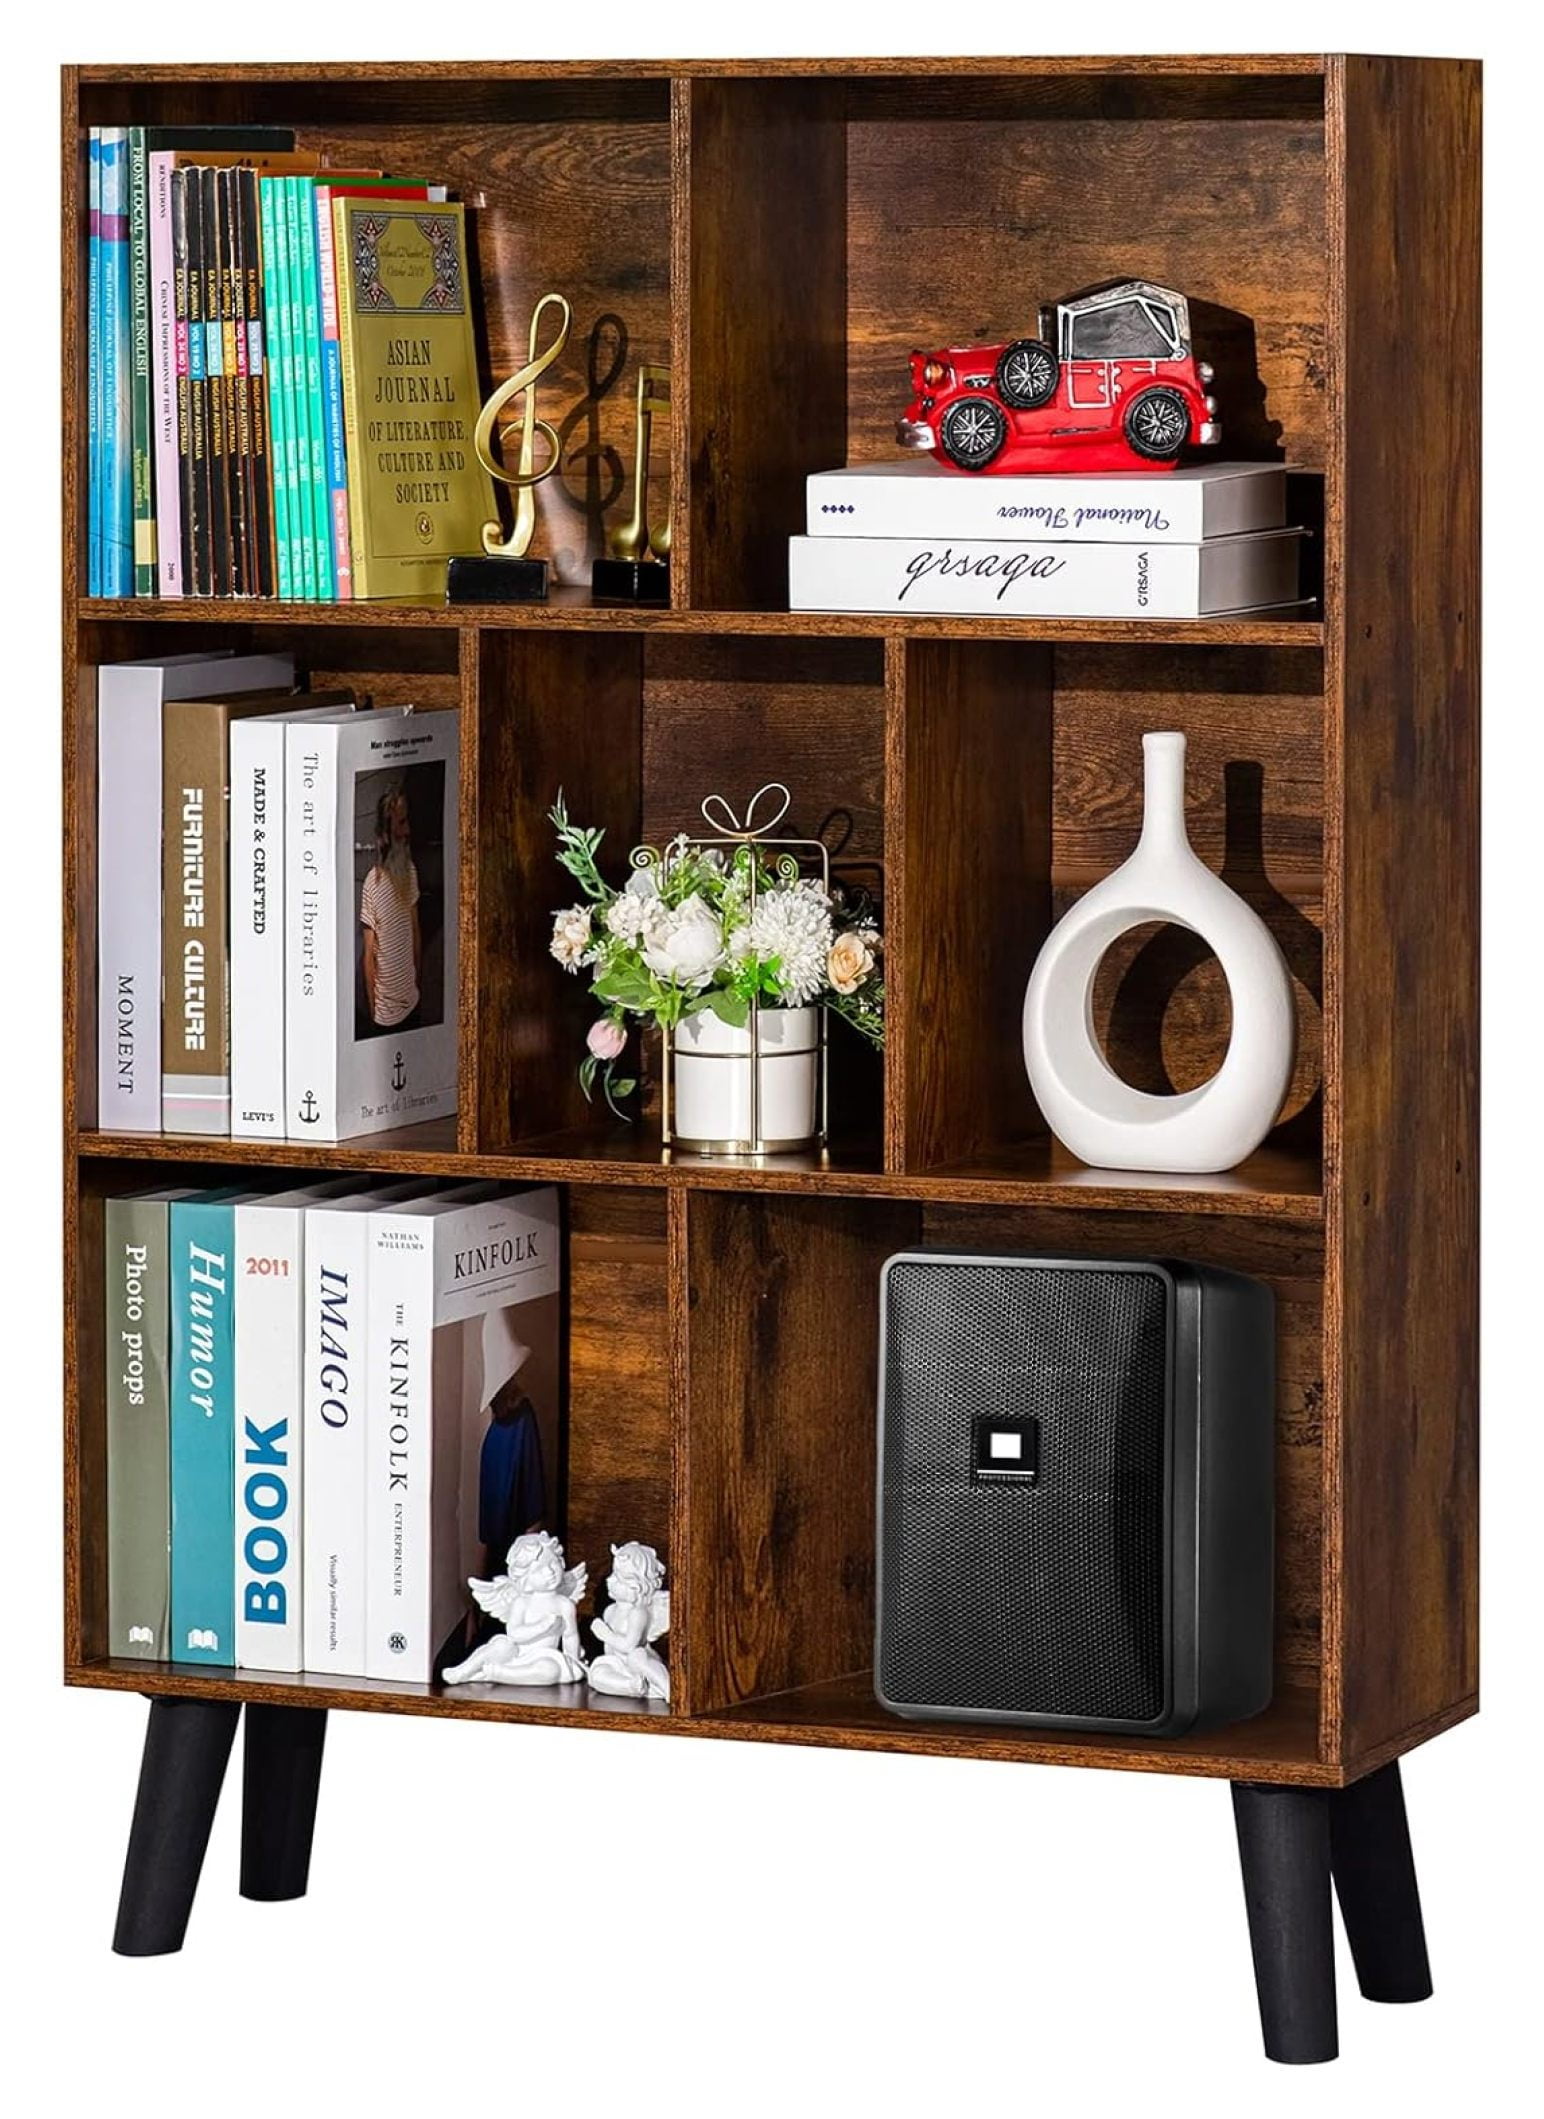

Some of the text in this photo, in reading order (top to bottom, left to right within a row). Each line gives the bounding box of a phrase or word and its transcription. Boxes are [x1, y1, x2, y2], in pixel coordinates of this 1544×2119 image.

[133, 147, 148, 376] FROM LOCAL TO GLOBAL ENGLISH
[176, 268, 186, 318] EA JOURNAL
[190, 271, 199, 320] EA JOURNAL
[208, 270, 217, 318] EA JOURNAL
[222, 269, 231, 318] EA JOURNAL
[235, 269, 244, 317] EA JOURNAL
[248, 269, 258, 318] EA JOURNAL
[105, 317, 114, 361] JOURNAL
[387, 339, 432, 366] ASIAN
[328, 357, 336, 390] JOURNAL
[375, 377, 455, 404] JOURNAL
[178, 376, 189, 455] ENGLISH AUSTRALIA
[194, 381, 204, 459] ENGLISH AUSTRALIA
[212, 377, 222, 455] ENGLISH AUSTRALIA
[226, 375, 236, 454] ENGLISH AUSTRALIA
[238, 377, 249, 455] ENGLISH AUSTRALIA
[253, 377, 263, 455] ENGLISH AUSTRALIA
[368, 421, 469, 442] OF LITERATURE,
[378, 450, 465, 473] CULTURE AND
[396, 482, 450, 504] SOCIETY
[996, 506, 1170, 530] National Flower
[167, 563, 175, 580] 2000
[897, 548, 1066, 600] grsaga
[254, 768, 266, 935] MADE & CRAFTED
[303, 753, 319, 996] The art of libraries
[184, 940, 205, 1050] CULTURE
[117, 975, 134, 1094] MOMENT
[242, 1111, 275, 1122] LEVI'S
[377, 1241, 425, 1250] WILLIAMS
[381, 1232, 419, 1240] NATHAN
[454, 1231, 539, 1280] KINFOLK
[245, 1256, 289, 1277] 2011
[121, 1244, 148, 1405] Photo props
[188, 1241, 226, 1418] Humor
[395, 1304, 404, 1325] THE
[319, 1265, 349, 1429] IMAGO
[389, 1338, 409, 1491] KINFOLK
[243, 1416, 288, 1625] BOOK
